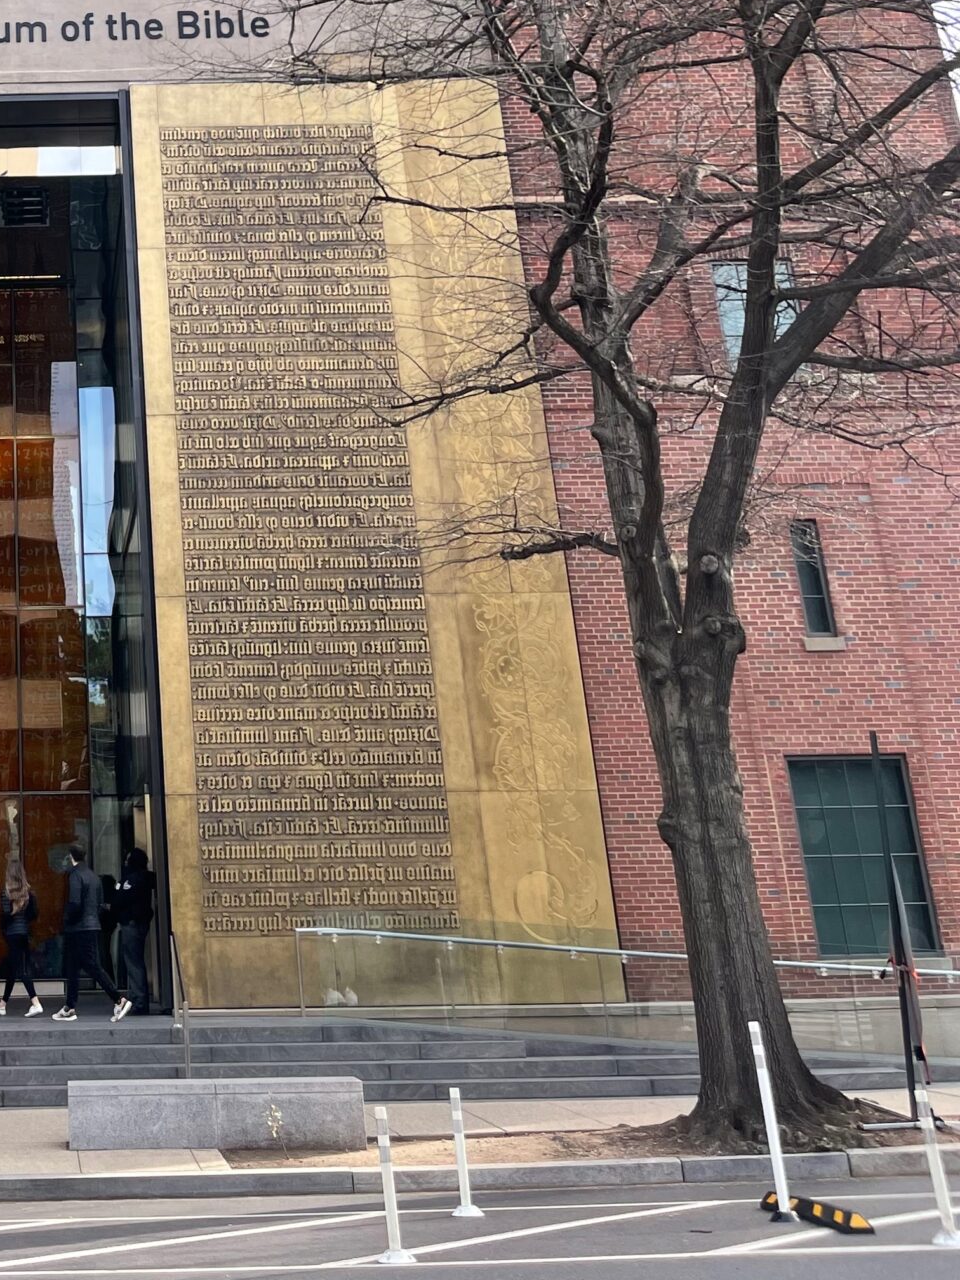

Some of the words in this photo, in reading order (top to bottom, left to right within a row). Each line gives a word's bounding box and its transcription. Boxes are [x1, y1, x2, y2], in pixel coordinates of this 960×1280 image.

[61, 12, 95, 43] of
[106, 12, 163, 42] the
[177, 9, 270, 40] Bible
